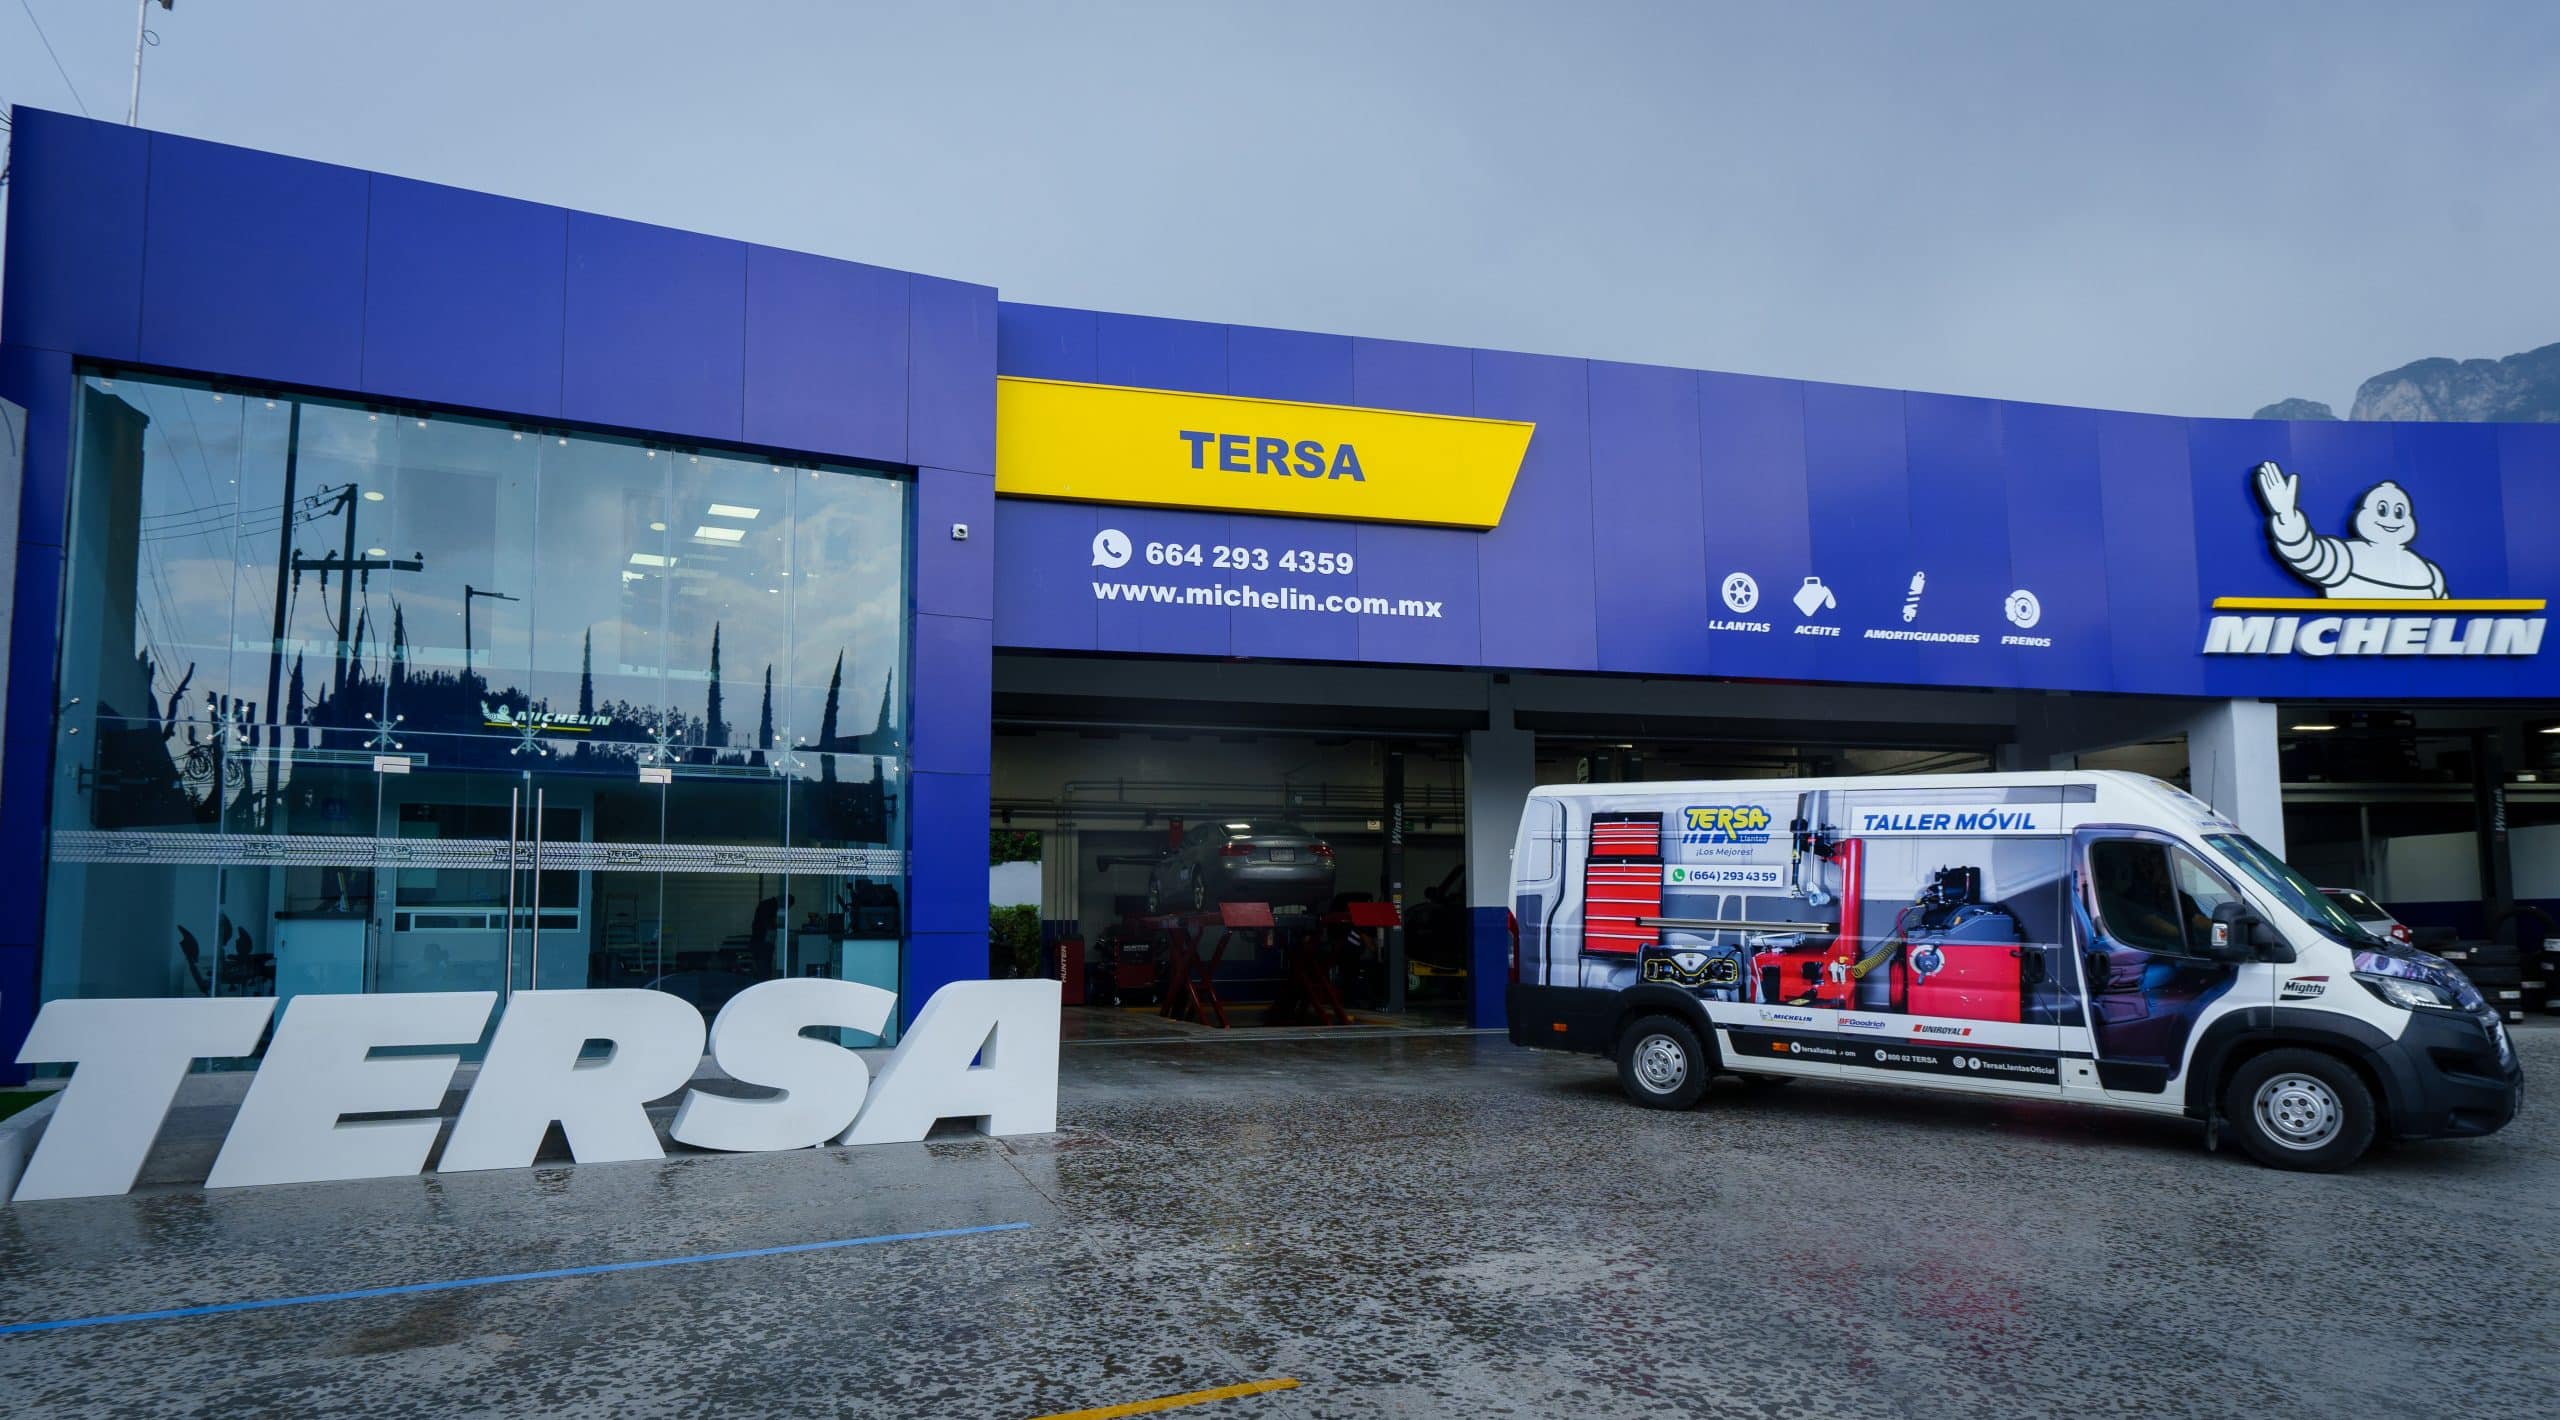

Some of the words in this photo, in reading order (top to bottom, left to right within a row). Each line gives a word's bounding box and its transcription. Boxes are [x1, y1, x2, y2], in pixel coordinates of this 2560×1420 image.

[1180, 430, 1366, 481] TERSA
[1145, 542, 1204, 568] 664
[1212, 544, 1270, 571] 293
[1278, 548, 1354, 575] 4359
[1092, 580, 1443, 618] www.michelin.com.mx
[1708, 620, 1771, 633] LLANTAS
[1794, 624, 1841, 637] ACEITE
[1863, 629, 1980, 644] AMORTIGUADORES
[2001, 635, 2052, 648] FRENOS
[2203, 615, 2547, 657] MICHELIN
[515, 711, 613, 726] MICHELIN
[1685, 806, 1772, 841] TERSA
[1863, 813, 1952, 831] TALLER
[1955, 807, 2036, 830] MÓVIL
[245, 842, 285, 856] TERSA
[496, 847, 529, 859] TESA
[1695, 848, 1714, 857] ¡Los
[1715, 848, 1754, 857] Mejores!
[608, 850, 641, 862] TERSA
[715, 852, 746, 863] TERSA
[839, 855, 867, 865] TERSA
[1689, 870, 1721, 882] (664)
[1723, 871, 1744, 881] 293
[1060, 945, 1068, 983] HUNTER
[2283, 981, 2326, 996] Mighty
[1773, 1014, 1813, 1022] MICHELIN
[1838, 1017, 1886, 1028] BFGoodrich
[1921, 1025, 1962, 1036] UNIROYAL
[1911, 1055, 1938, 1064] TERSA
[12, 977, 1062, 1202] TERSA
